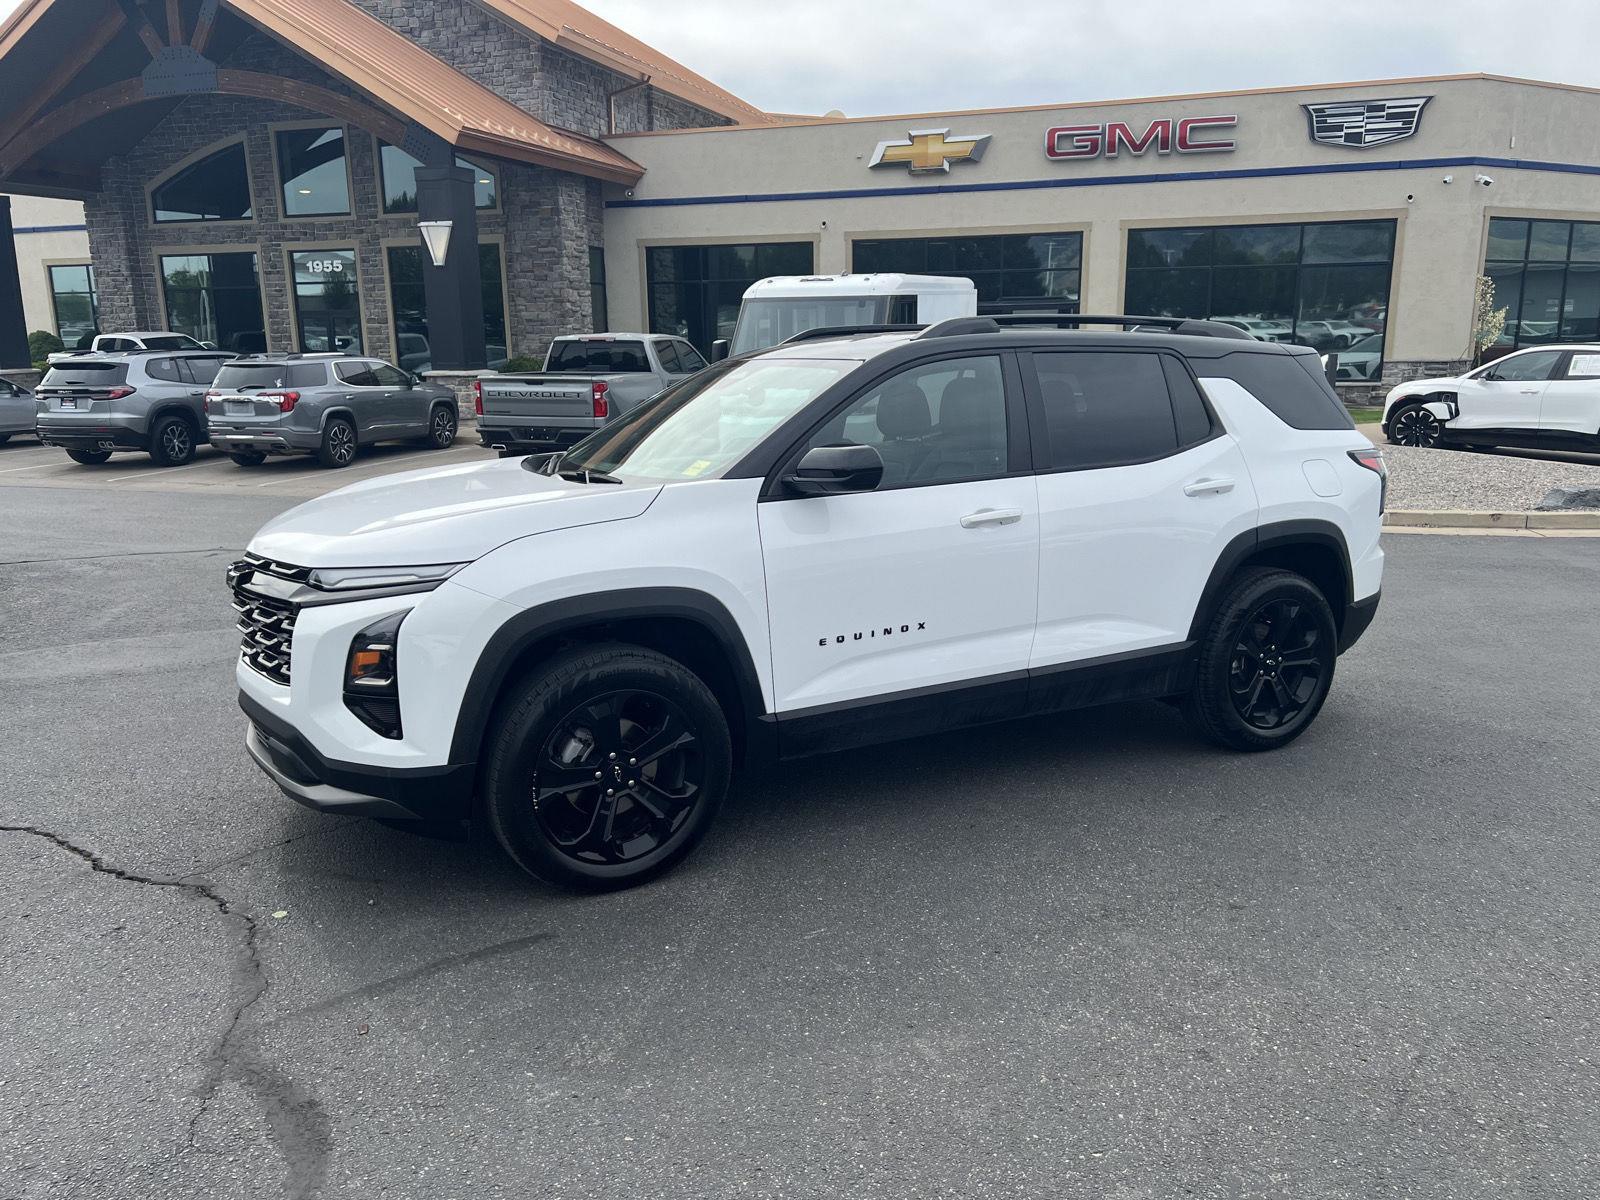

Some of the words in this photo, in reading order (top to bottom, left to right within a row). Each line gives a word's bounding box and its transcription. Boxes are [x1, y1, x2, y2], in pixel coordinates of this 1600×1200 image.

[1045, 114, 1238, 161] GMC
[306, 260, 343, 273] 1955
[487, 390, 584, 399] CHEVROLET
[818, 621, 926, 647] EQUINOX
